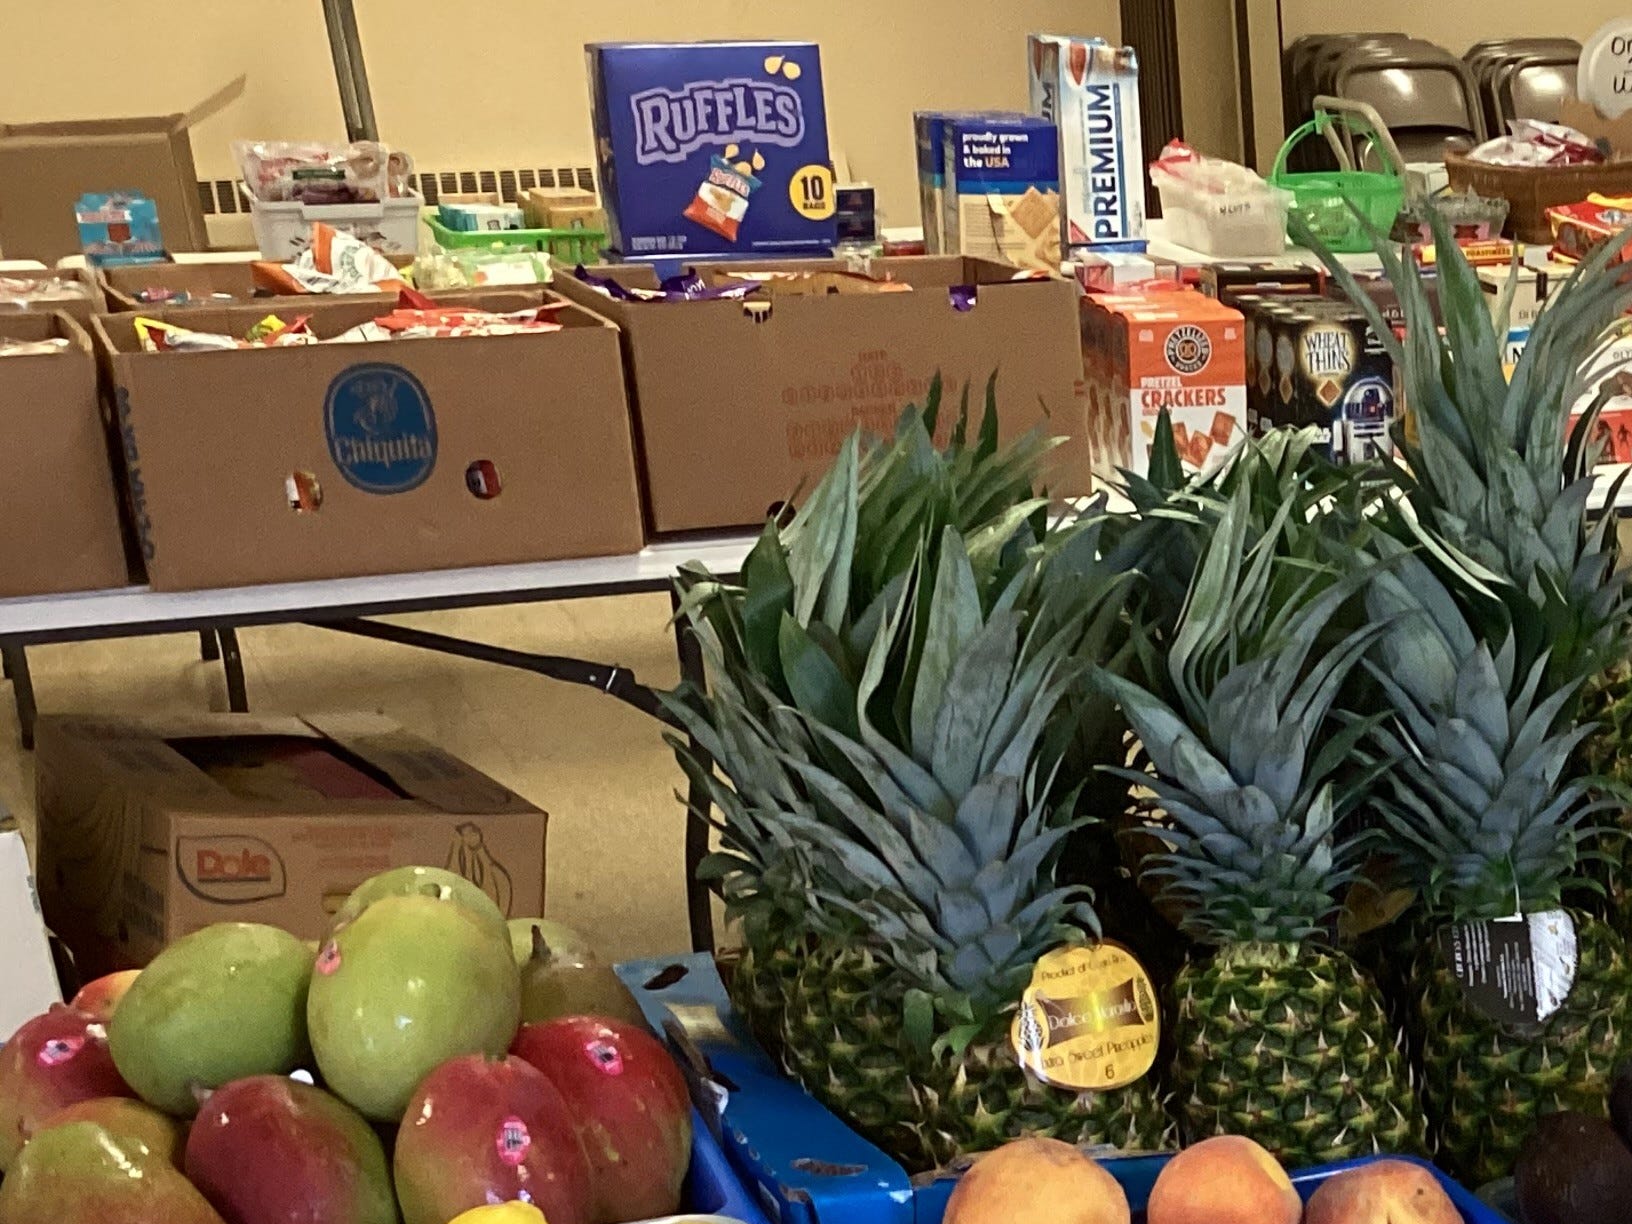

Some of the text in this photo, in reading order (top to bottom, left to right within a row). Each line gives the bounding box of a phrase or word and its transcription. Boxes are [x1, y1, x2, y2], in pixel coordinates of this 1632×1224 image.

[638, 84, 801, 153] RUFFLES
[962, 131, 1029, 145] proudly grown
[972, 143, 1001, 155] baked
[1002, 144, 1012, 155] in
[963, 155, 1010, 169] the USA
[1086, 83, 1119, 239] PREMIUM
[800, 175, 825, 201] 10
[1304, 331, 1348, 352] WHEAT
[1307, 351, 1351, 373] THINS
[1141, 388, 1227, 408] CRACKERS
[334, 433, 432, 468] Chiquita
[196, 849, 272, 879] Dole
